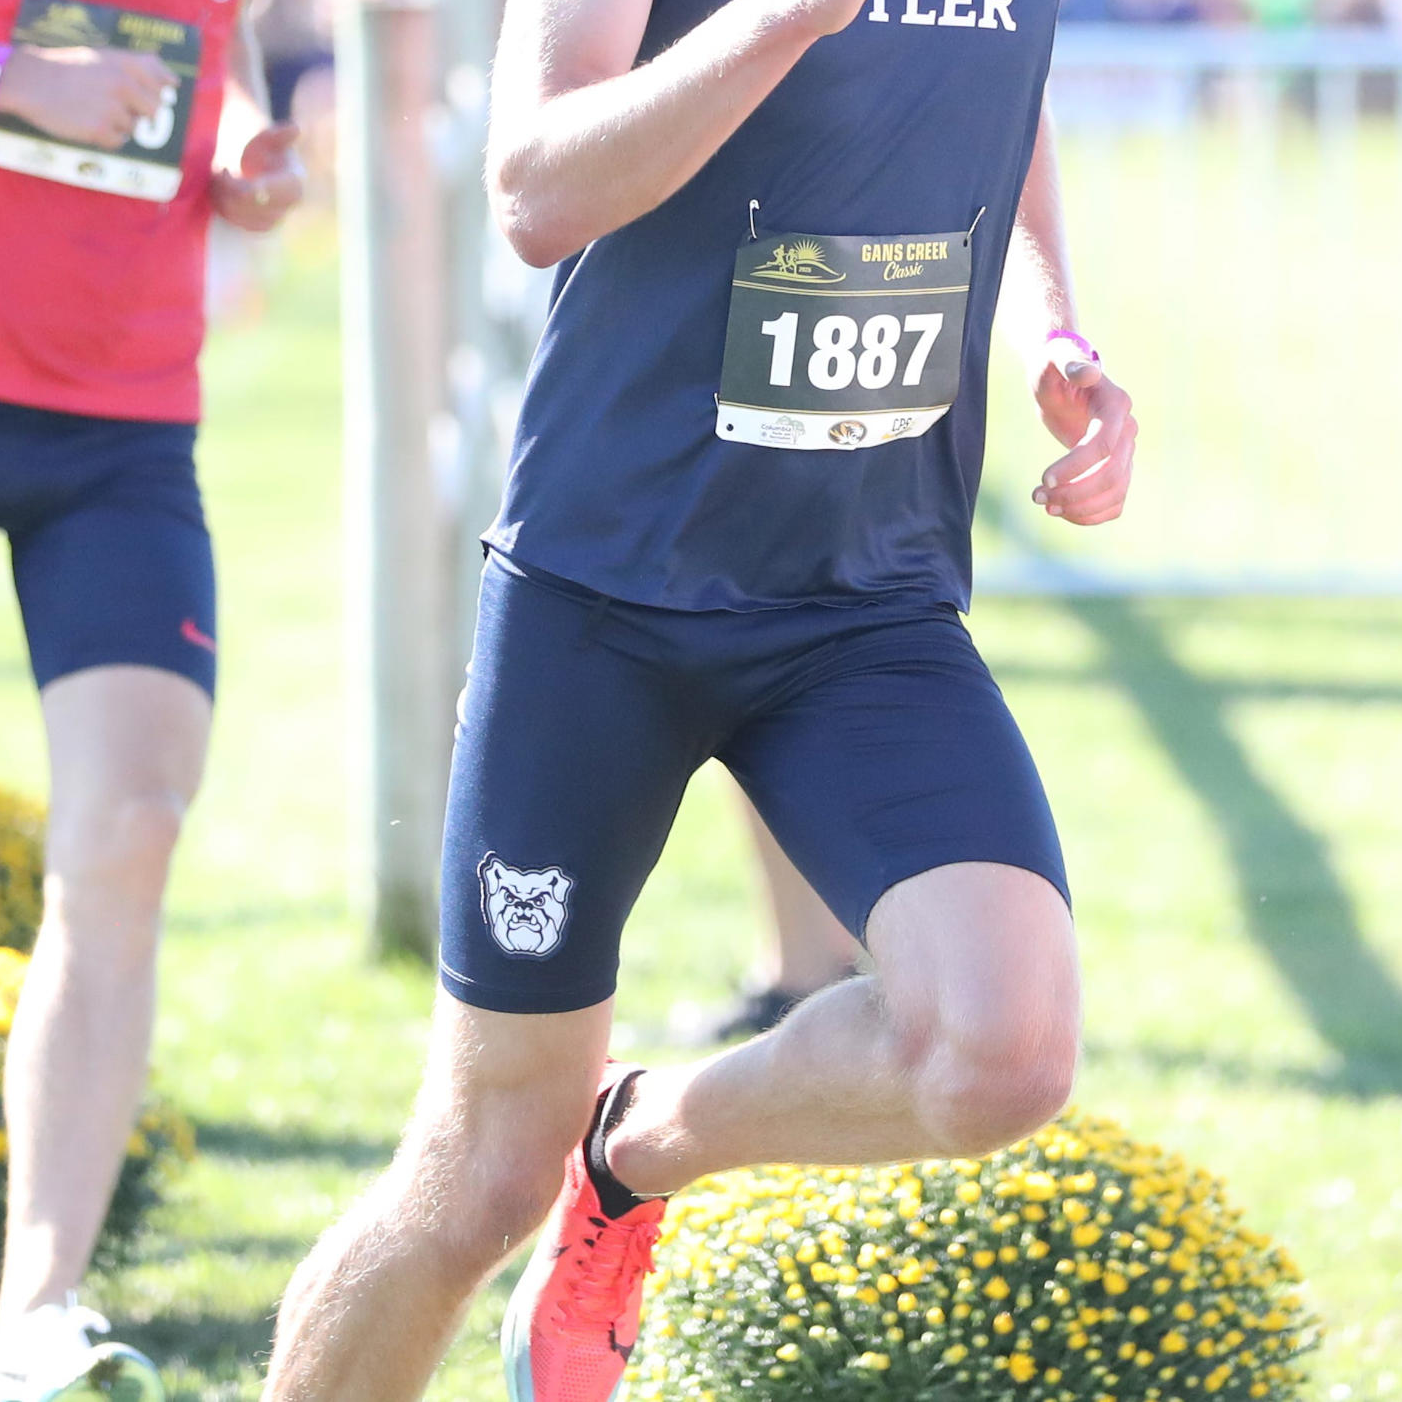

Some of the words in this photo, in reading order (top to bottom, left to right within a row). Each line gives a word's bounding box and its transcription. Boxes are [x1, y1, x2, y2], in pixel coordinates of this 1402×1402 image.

[861, 244, 904, 262] GANS
[906, 241, 948, 262] CREEK
[883, 261, 924, 281] Classic
[761, 311, 944, 390] 1887
